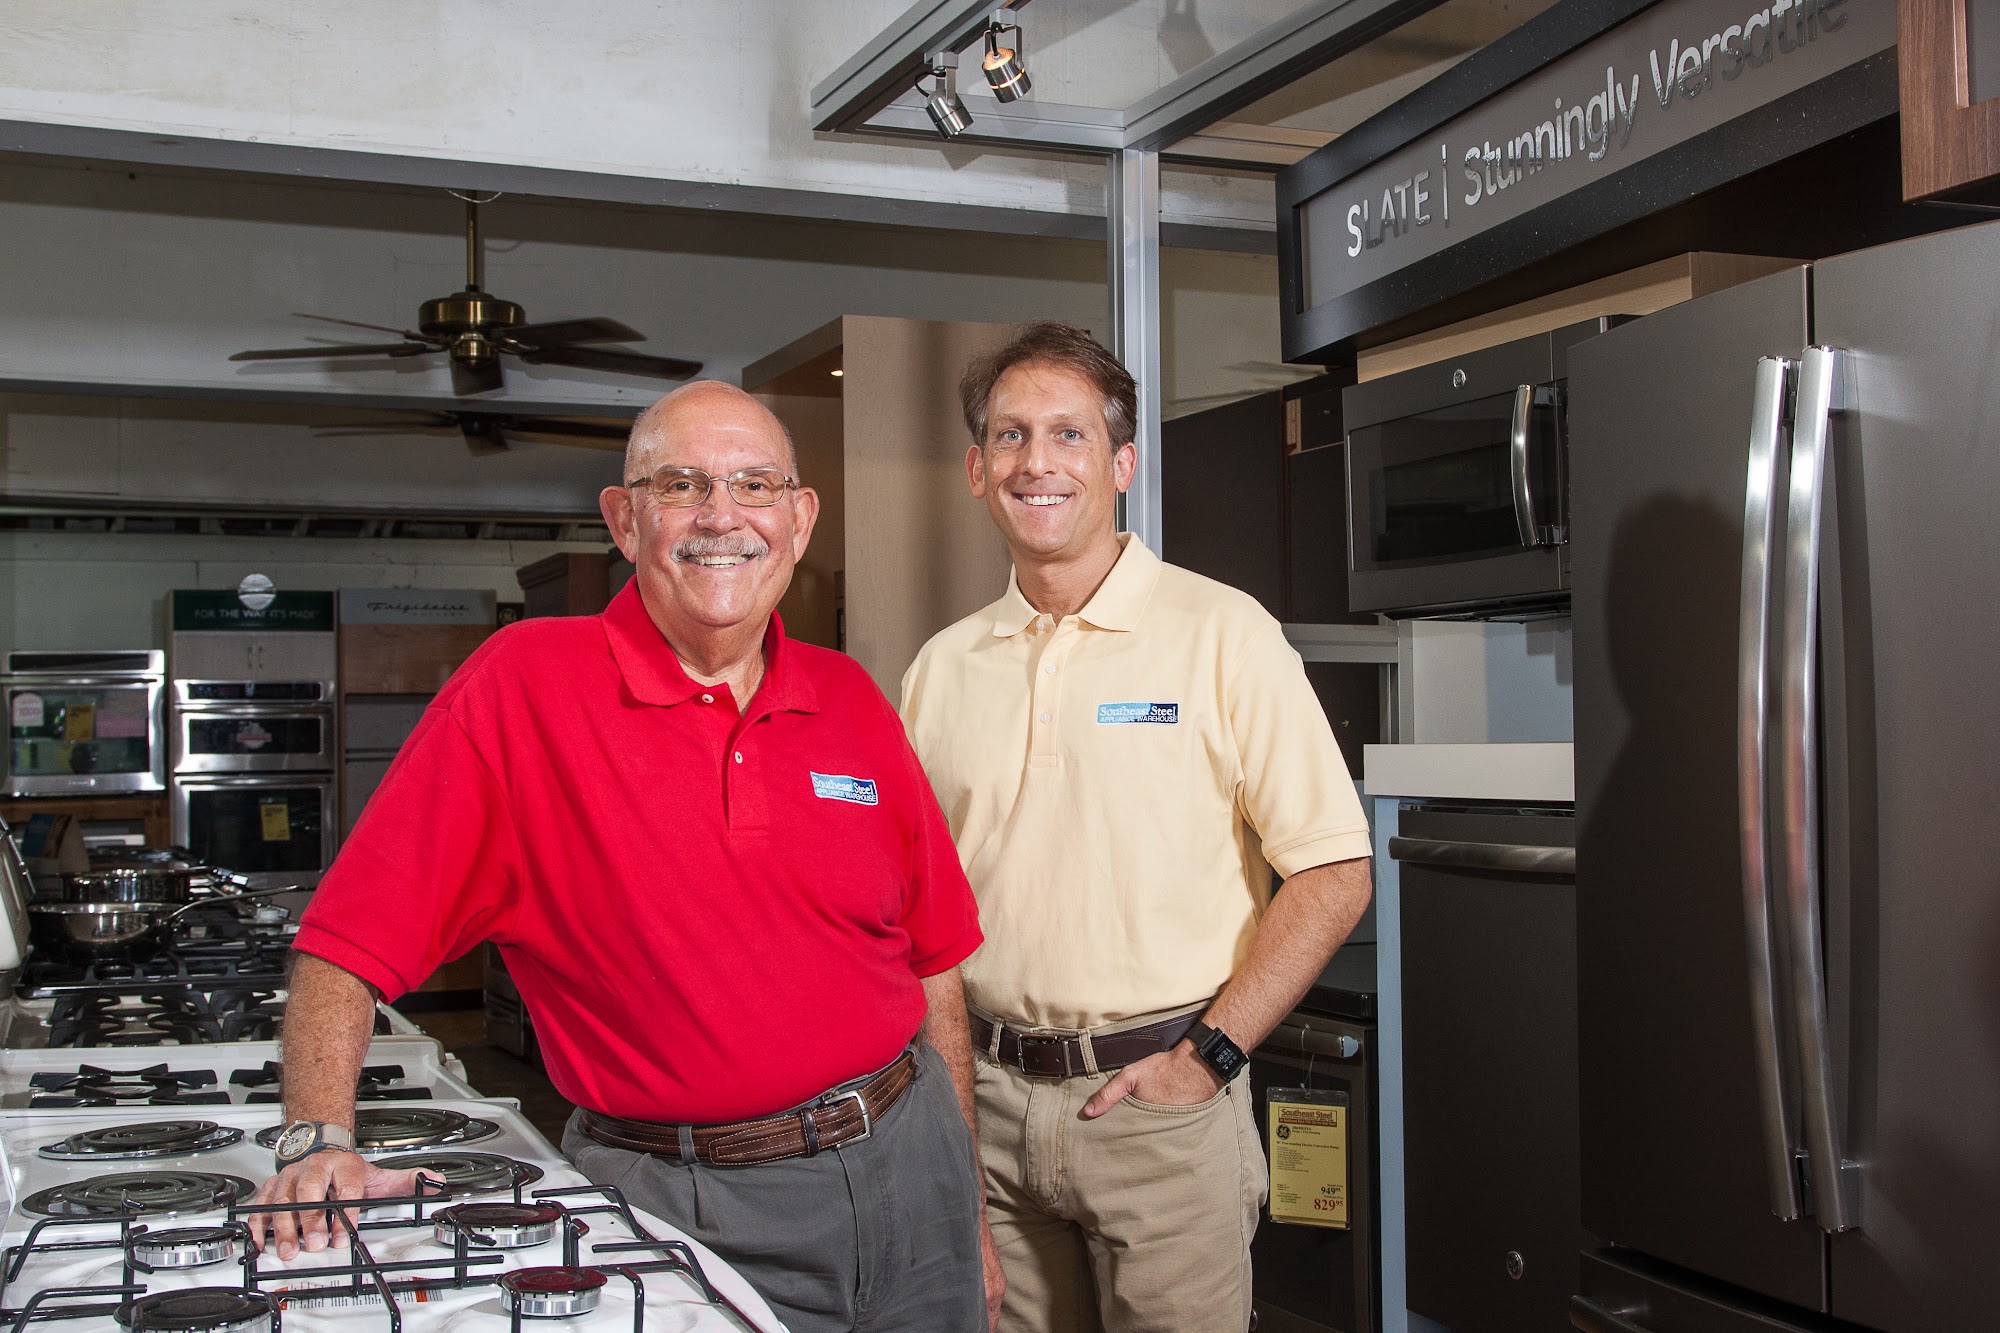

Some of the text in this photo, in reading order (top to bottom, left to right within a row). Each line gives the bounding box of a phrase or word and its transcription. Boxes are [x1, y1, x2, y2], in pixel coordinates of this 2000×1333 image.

[1347, 170, 1431, 258] SLATE
[1463, 67, 1640, 206] Stunningly
[194, 609, 216, 619] FOR
[219, 609, 240, 619] THE
[242, 609, 267, 619] WAY
[1099, 705, 1176, 717] Southeast Steel
[1137, 715, 1177, 723] WAREHOUSE
[812, 776, 874, 795] Southeast Steel
[845, 792, 877, 802] WAREHOUSE
[1281, 1108, 1333, 1119] Southeast Steel
